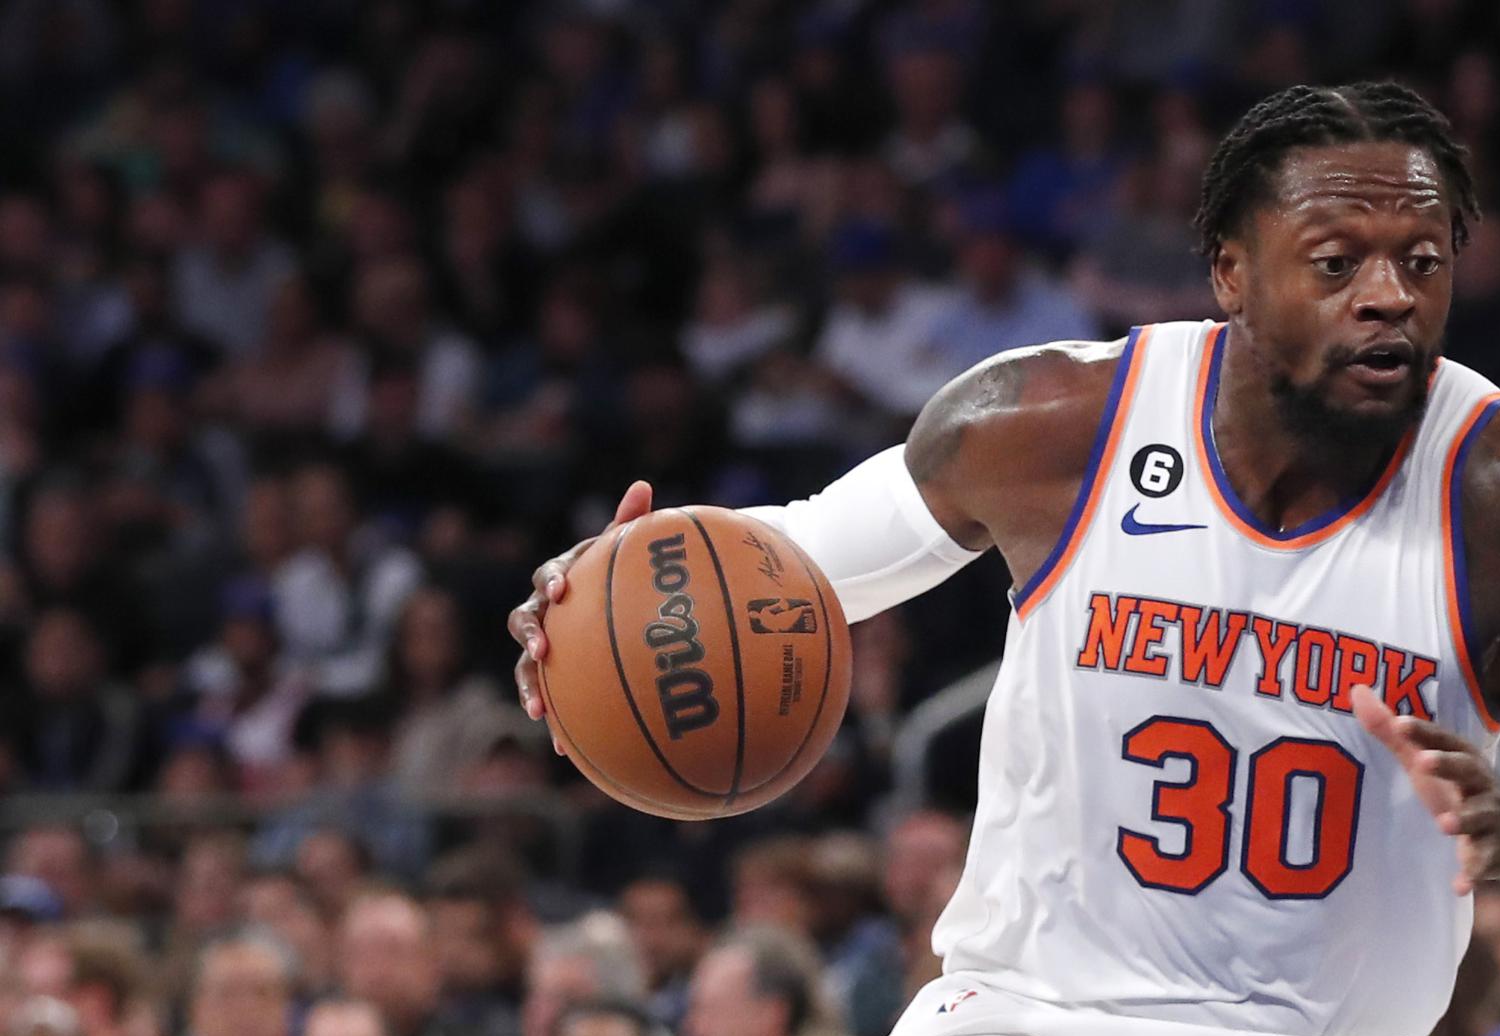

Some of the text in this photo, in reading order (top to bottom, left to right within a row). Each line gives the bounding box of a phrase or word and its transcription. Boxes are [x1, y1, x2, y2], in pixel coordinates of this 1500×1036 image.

[1139, 450, 1176, 493] 6
[643, 533, 721, 741] Wilson
[1074, 590, 1442, 722] NEW YORK
[1116, 714, 1366, 901] 30
